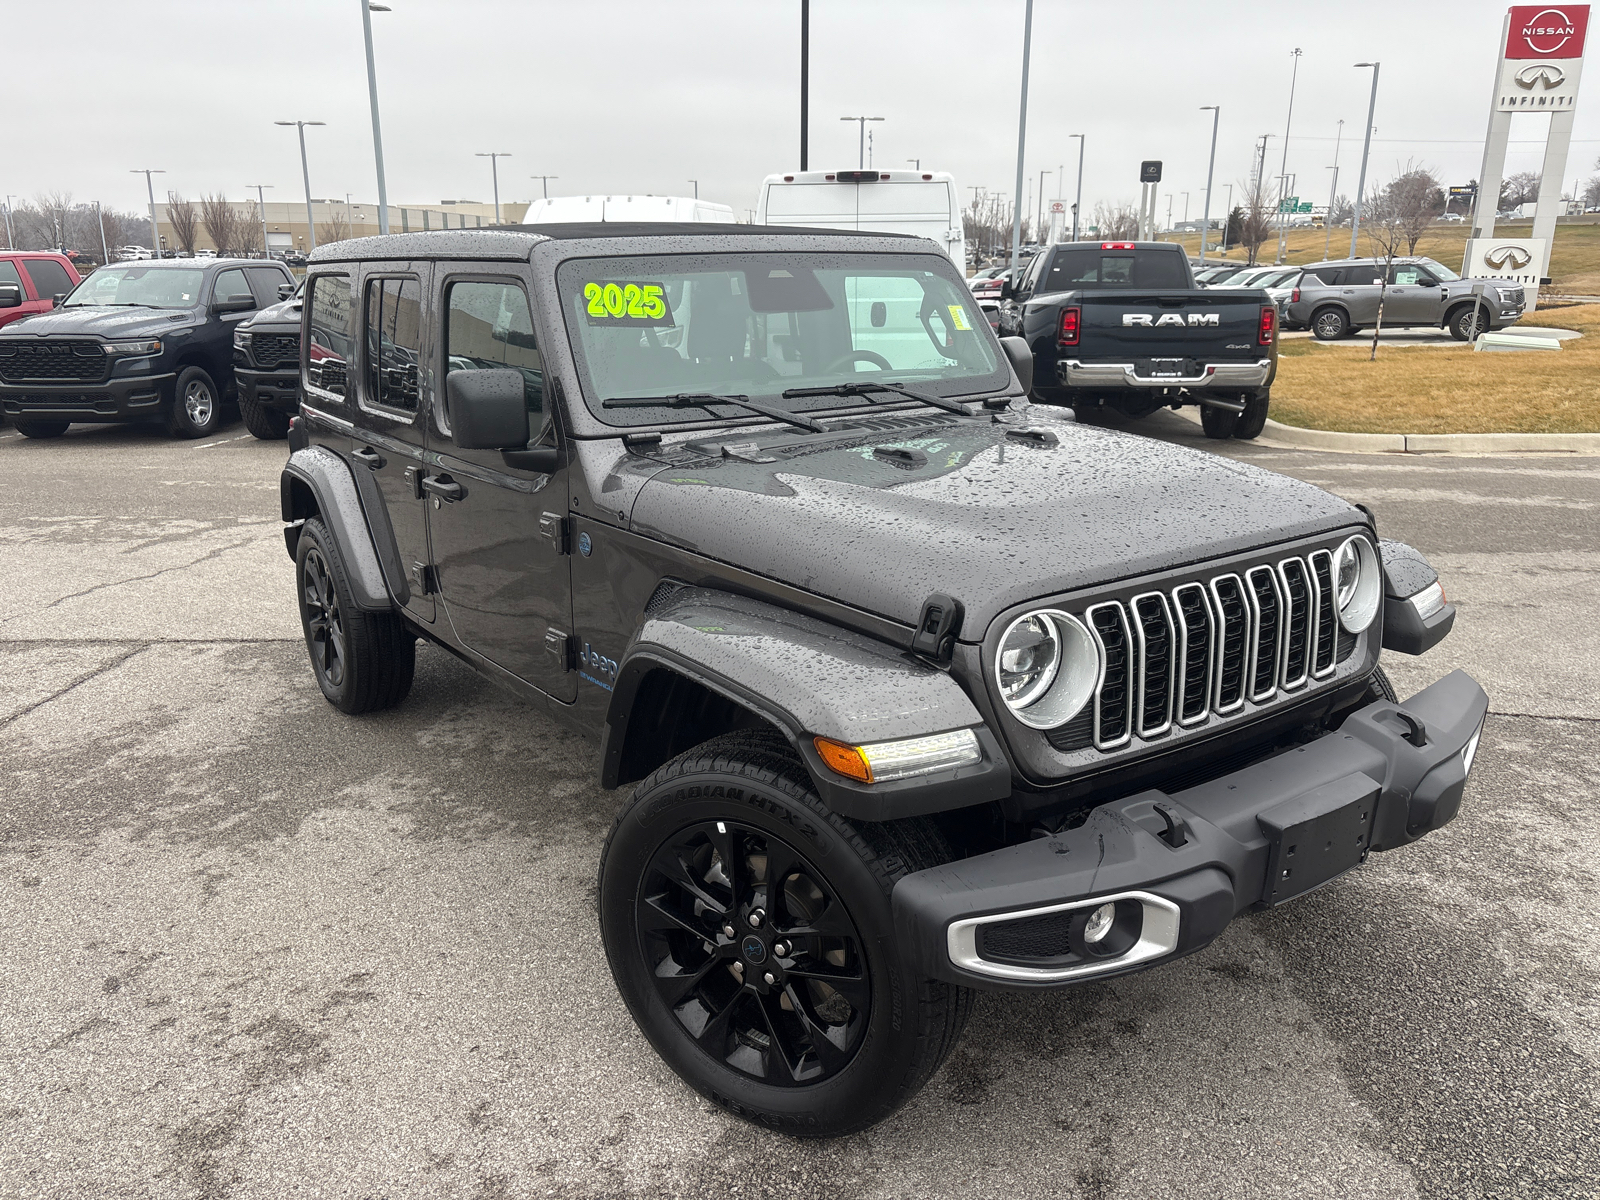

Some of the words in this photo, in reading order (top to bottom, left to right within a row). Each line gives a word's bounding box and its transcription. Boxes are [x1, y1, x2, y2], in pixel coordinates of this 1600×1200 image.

[1522, 27, 1575, 36] NISSAN
[1501, 96, 1573, 106] INFINITI
[584, 282, 666, 319] 2025
[1122, 313, 1220, 327] RAM
[18, 345, 71, 355] RAM
[580, 642, 618, 682] Jeep
[586, 673, 614, 692] WRANGL
[649, 785, 745, 818] ROADIAN
